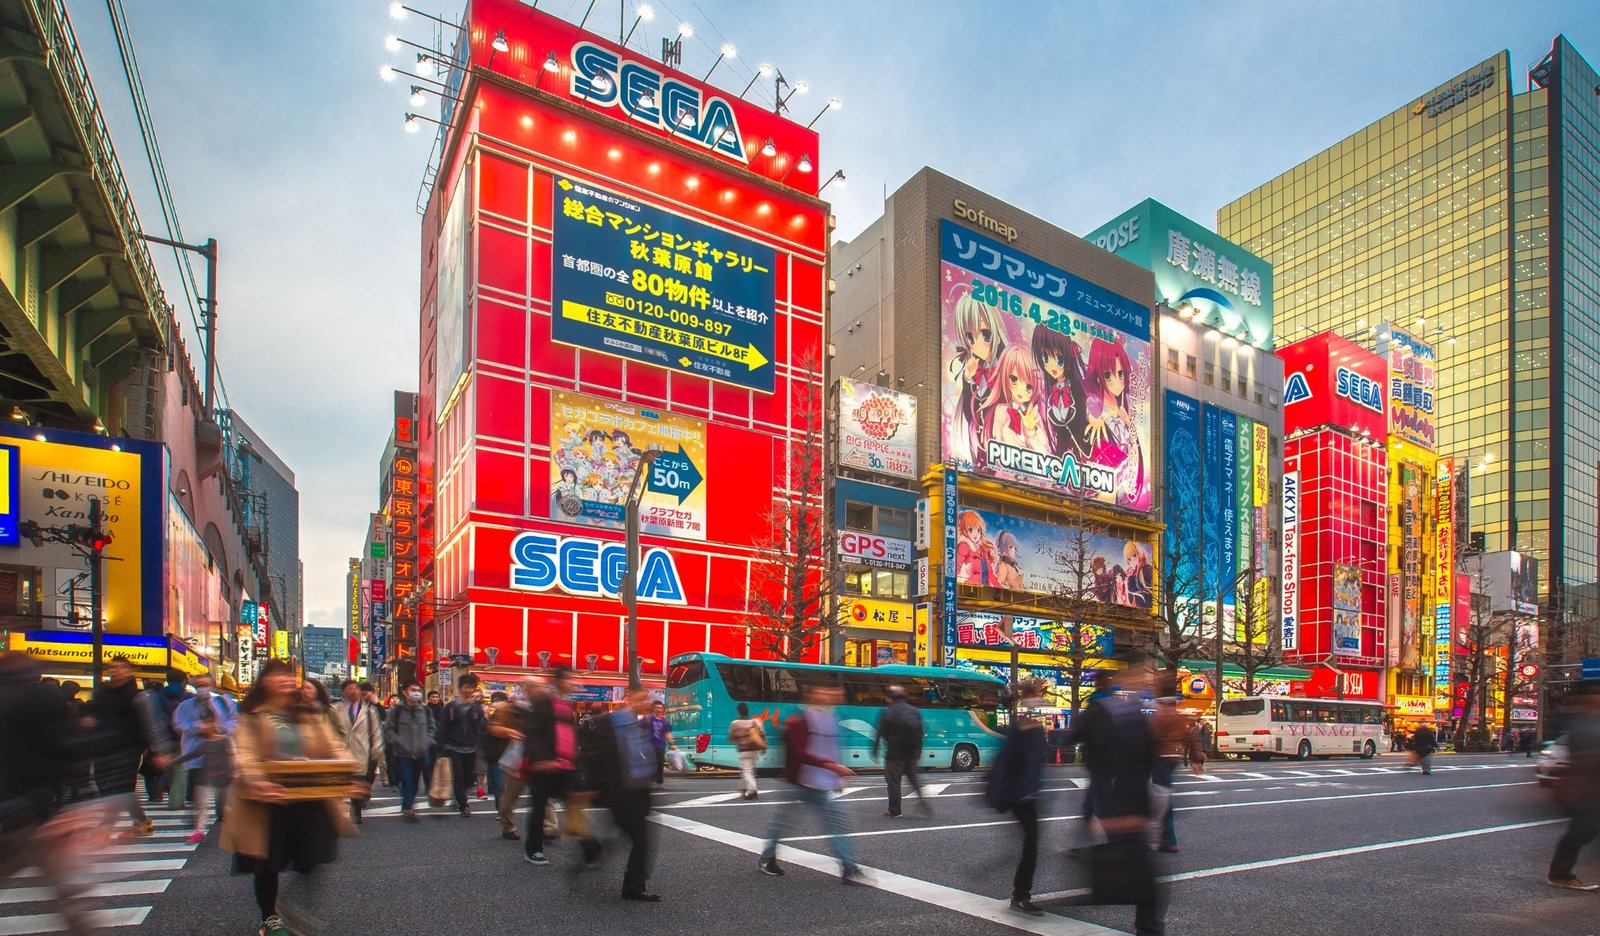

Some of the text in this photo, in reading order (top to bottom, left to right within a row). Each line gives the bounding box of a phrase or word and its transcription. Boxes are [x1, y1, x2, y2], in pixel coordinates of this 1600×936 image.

[571, 42, 747, 163] SEGA
[953, 199, 1018, 242] Sofmap
[563, 197, 769, 273] 総合マンションギャラリー
[630, 240, 713, 282] 秋葉原館
[952, 233, 1143, 327] ソフマップ アミューズメント館
[626, 296, 732, 338] 0120-009-897
[586, 308, 749, 360] 住友不動産秋葉原ビル8F
[1073, 318, 1088, 333] ON
[1090, 322, 1115, 343] SALE
[1335, 366, 1384, 414] SEGA
[1391, 377, 1434, 412] 高額買取
[641, 410, 659, 419] SEGA
[852, 408, 868, 421] BIG
[846, 434, 861, 447] BIG
[653, 457, 689, 472] ここから
[32, 471, 130, 490] SHISEIDO
[653, 470, 690, 491] 50m
[1284, 476, 1296, 508] AKKY
[75, 492, 122, 505] KOSÉ
[45, 506, 119, 523] Kanbo
[640, 514, 701, 531] 秋葉原新館 7階
[649, 506, 692, 519] クラブセガ
[840, 532, 886, 559] GPS
[887, 552, 906, 561] next
[1284, 525, 1296, 580] Tax-free
[395, 478, 412, 658] 東京ラジオデパート
[510, 531, 687, 605] SEGA
[1284, 582, 1296, 615] Shop
[1391, 576, 1400, 598] GAME
[873, 609, 899, 623] 松屋
[26, 646, 94, 658] Matsumot
[918, 642, 925, 667] 松屋
[1350, 673, 1363, 695] SEGA
[1288, 723, 1357, 737] YUNAGI
